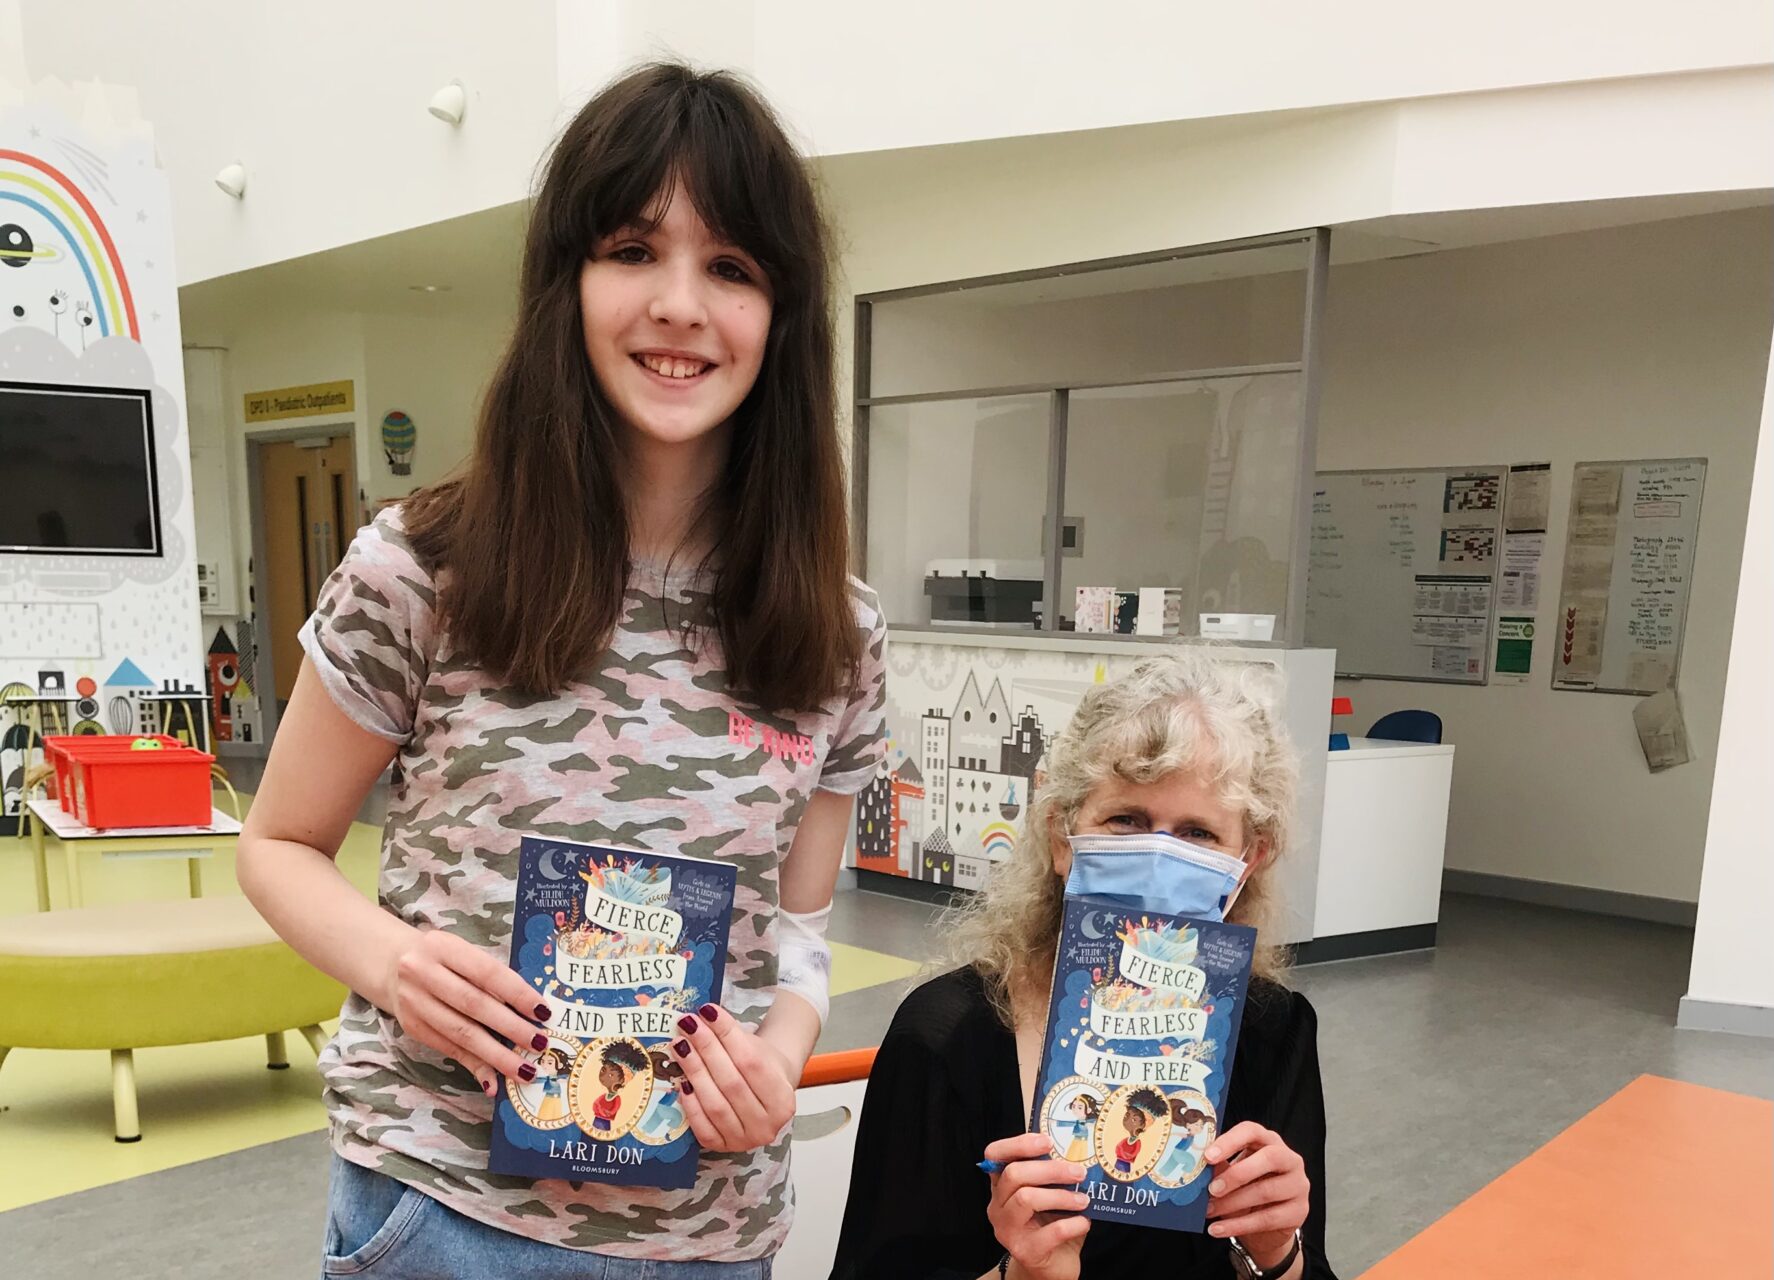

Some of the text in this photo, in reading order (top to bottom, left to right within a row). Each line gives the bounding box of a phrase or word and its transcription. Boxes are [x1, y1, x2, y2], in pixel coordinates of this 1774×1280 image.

[728, 712, 814, 766] BE KIND
[593, 897, 675, 940] FIERCE,
[568, 958, 676, 984] FEARLESS
[1126, 954, 1200, 994] FIERCE,
[558, 1008, 674, 1034] AND FREE
[1101, 1012, 1198, 1036] FEARLESS
[1088, 1057, 1193, 1082] AND FREE
[549, 1140, 645, 1166] LARI DON
[572, 1164, 621, 1175] BLOOMSBURY
[1092, 1204, 1138, 1215] BLOOMSBURY
[1124, 1189, 1161, 1208] DON
